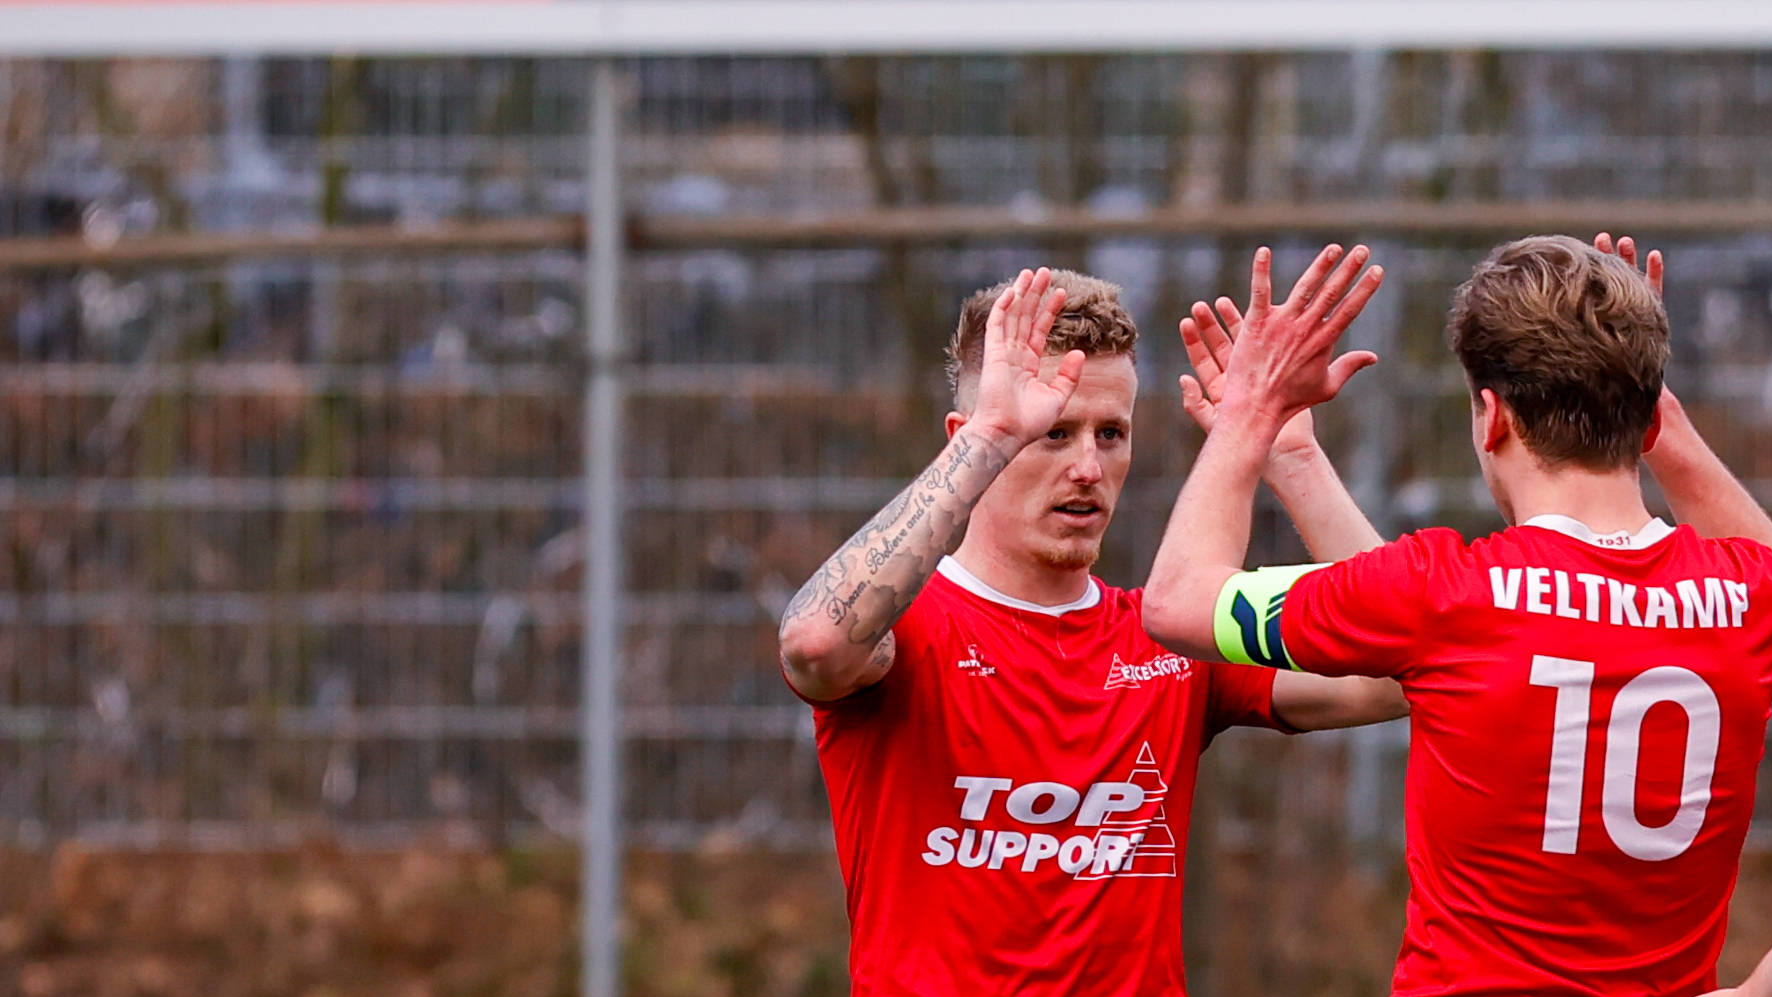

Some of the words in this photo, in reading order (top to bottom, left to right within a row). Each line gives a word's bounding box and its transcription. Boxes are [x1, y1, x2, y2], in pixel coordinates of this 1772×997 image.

[906, 498, 925, 530] and
[1597, 536, 1631, 546] 1931
[1489, 566, 1749, 629] VELTKAMP
[1529, 654, 1721, 861] 10
[954, 776, 1145, 826] TOP
[921, 827, 1145, 874] SUPPORT
